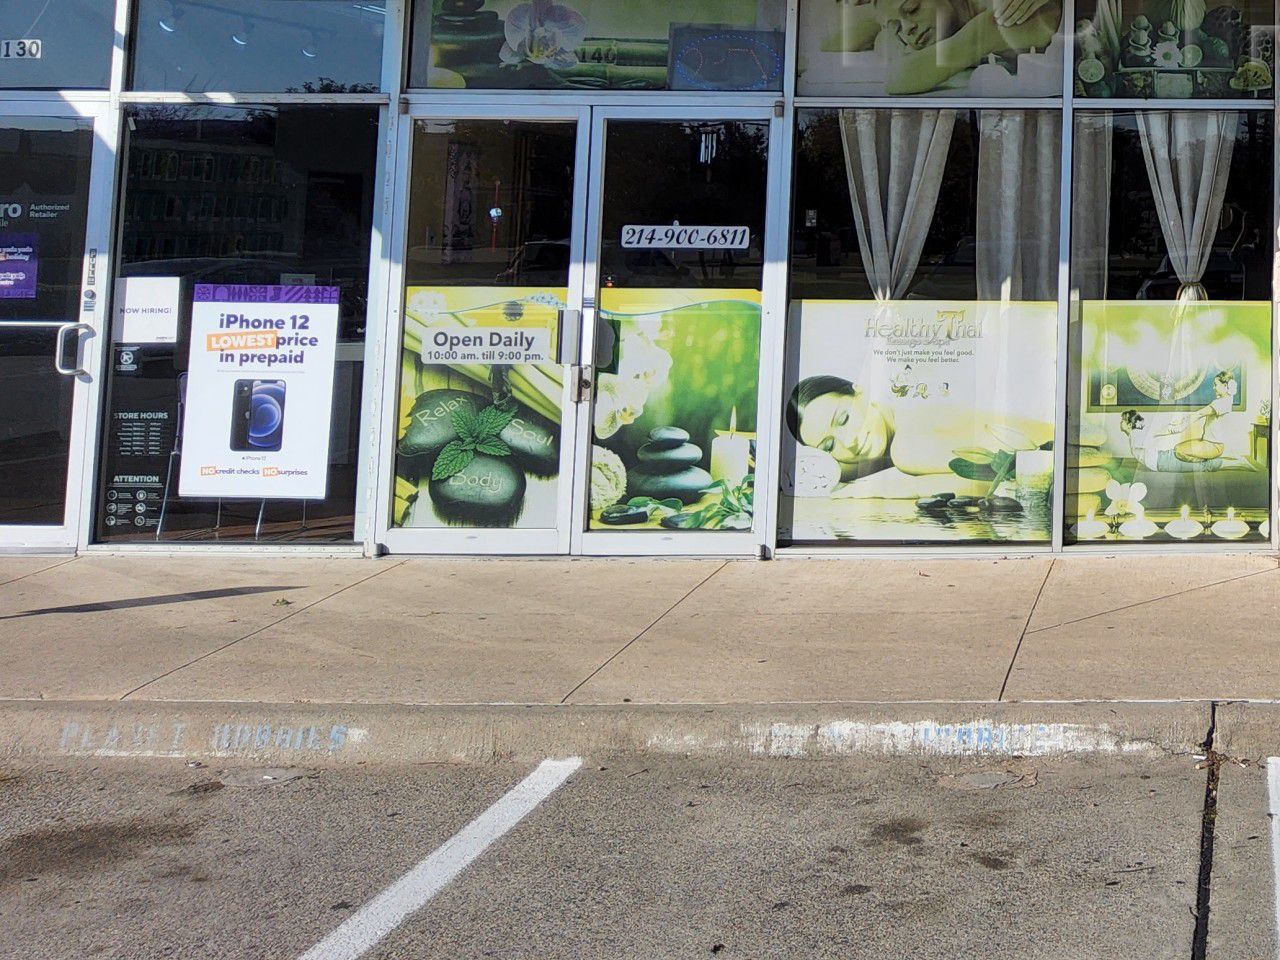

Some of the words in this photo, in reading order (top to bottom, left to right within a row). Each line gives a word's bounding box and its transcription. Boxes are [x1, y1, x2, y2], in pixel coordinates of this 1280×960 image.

[30, 203, 70, 211] Authorized
[624, 228, 747, 246] 214-900-6811
[119, 307, 139, 315] NOW
[218, 313, 286, 330] iPhone
[289, 314, 310, 330] 12
[210, 334, 275, 349] LOWEST
[275, 332, 319, 349] price
[433, 331, 483, 351] Open
[489, 331, 535, 352] Daily
[219, 348, 235, 363] in
[239, 349, 305, 367] prepaid
[427, 350, 458, 361] 10:00
[460, 353, 480, 361] am.
[482, 351, 496, 361] till
[497, 351, 522, 361] 9:00
[524, 353, 545, 363] pm.
[113, 411, 140, 420] STORE
[140, 411, 169, 420] HOURS
[415, 395, 468, 428] Relax
[511, 418, 554, 447] Soul
[113, 475, 160, 483] ATTENTION
[201, 467, 215, 476] NO
[263, 468, 277, 476] NO
[277, 468, 308, 477] surprises
